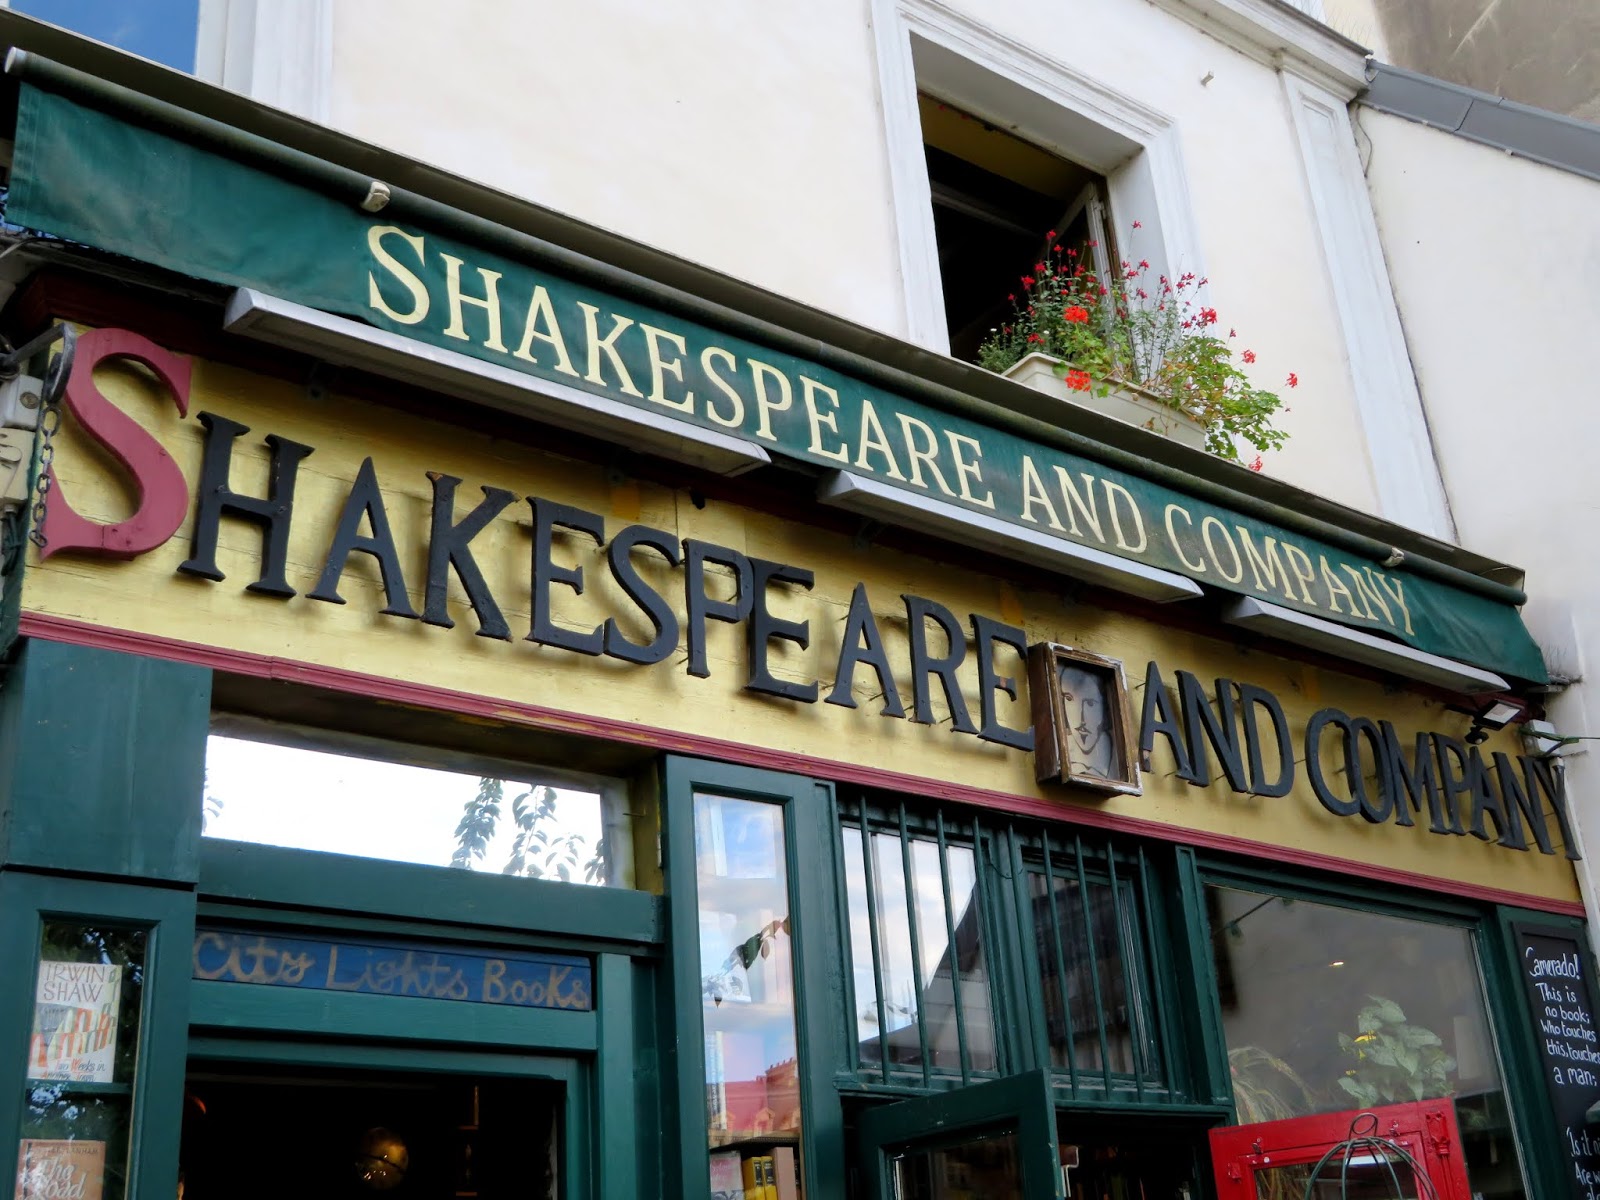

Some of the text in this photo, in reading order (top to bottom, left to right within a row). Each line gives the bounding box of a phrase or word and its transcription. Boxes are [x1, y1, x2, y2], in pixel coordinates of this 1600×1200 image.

[367, 225, 1417, 637] SHAKESPEARE AND COMPANY
[40, 327, 1583, 861] SHAKESPEARE AND COMPANY
[46, 964, 105, 982] IRWIN
[193, 931, 317, 984] City
[324, 944, 469, 1000] Lights
[1525, 947, 1580, 980] Camerado!
[43, 981, 104, 1002] SHAW
[1535, 983, 1577, 1002] This is
[1545, 1005, 1590, 1024] no book;
[1561, 1021, 1597, 1042] touches
[1567, 1043, 1600, 1064] touches
[1554, 1067, 1598, 1087] a man;
[1574, 1161, 1594, 1186] Are
